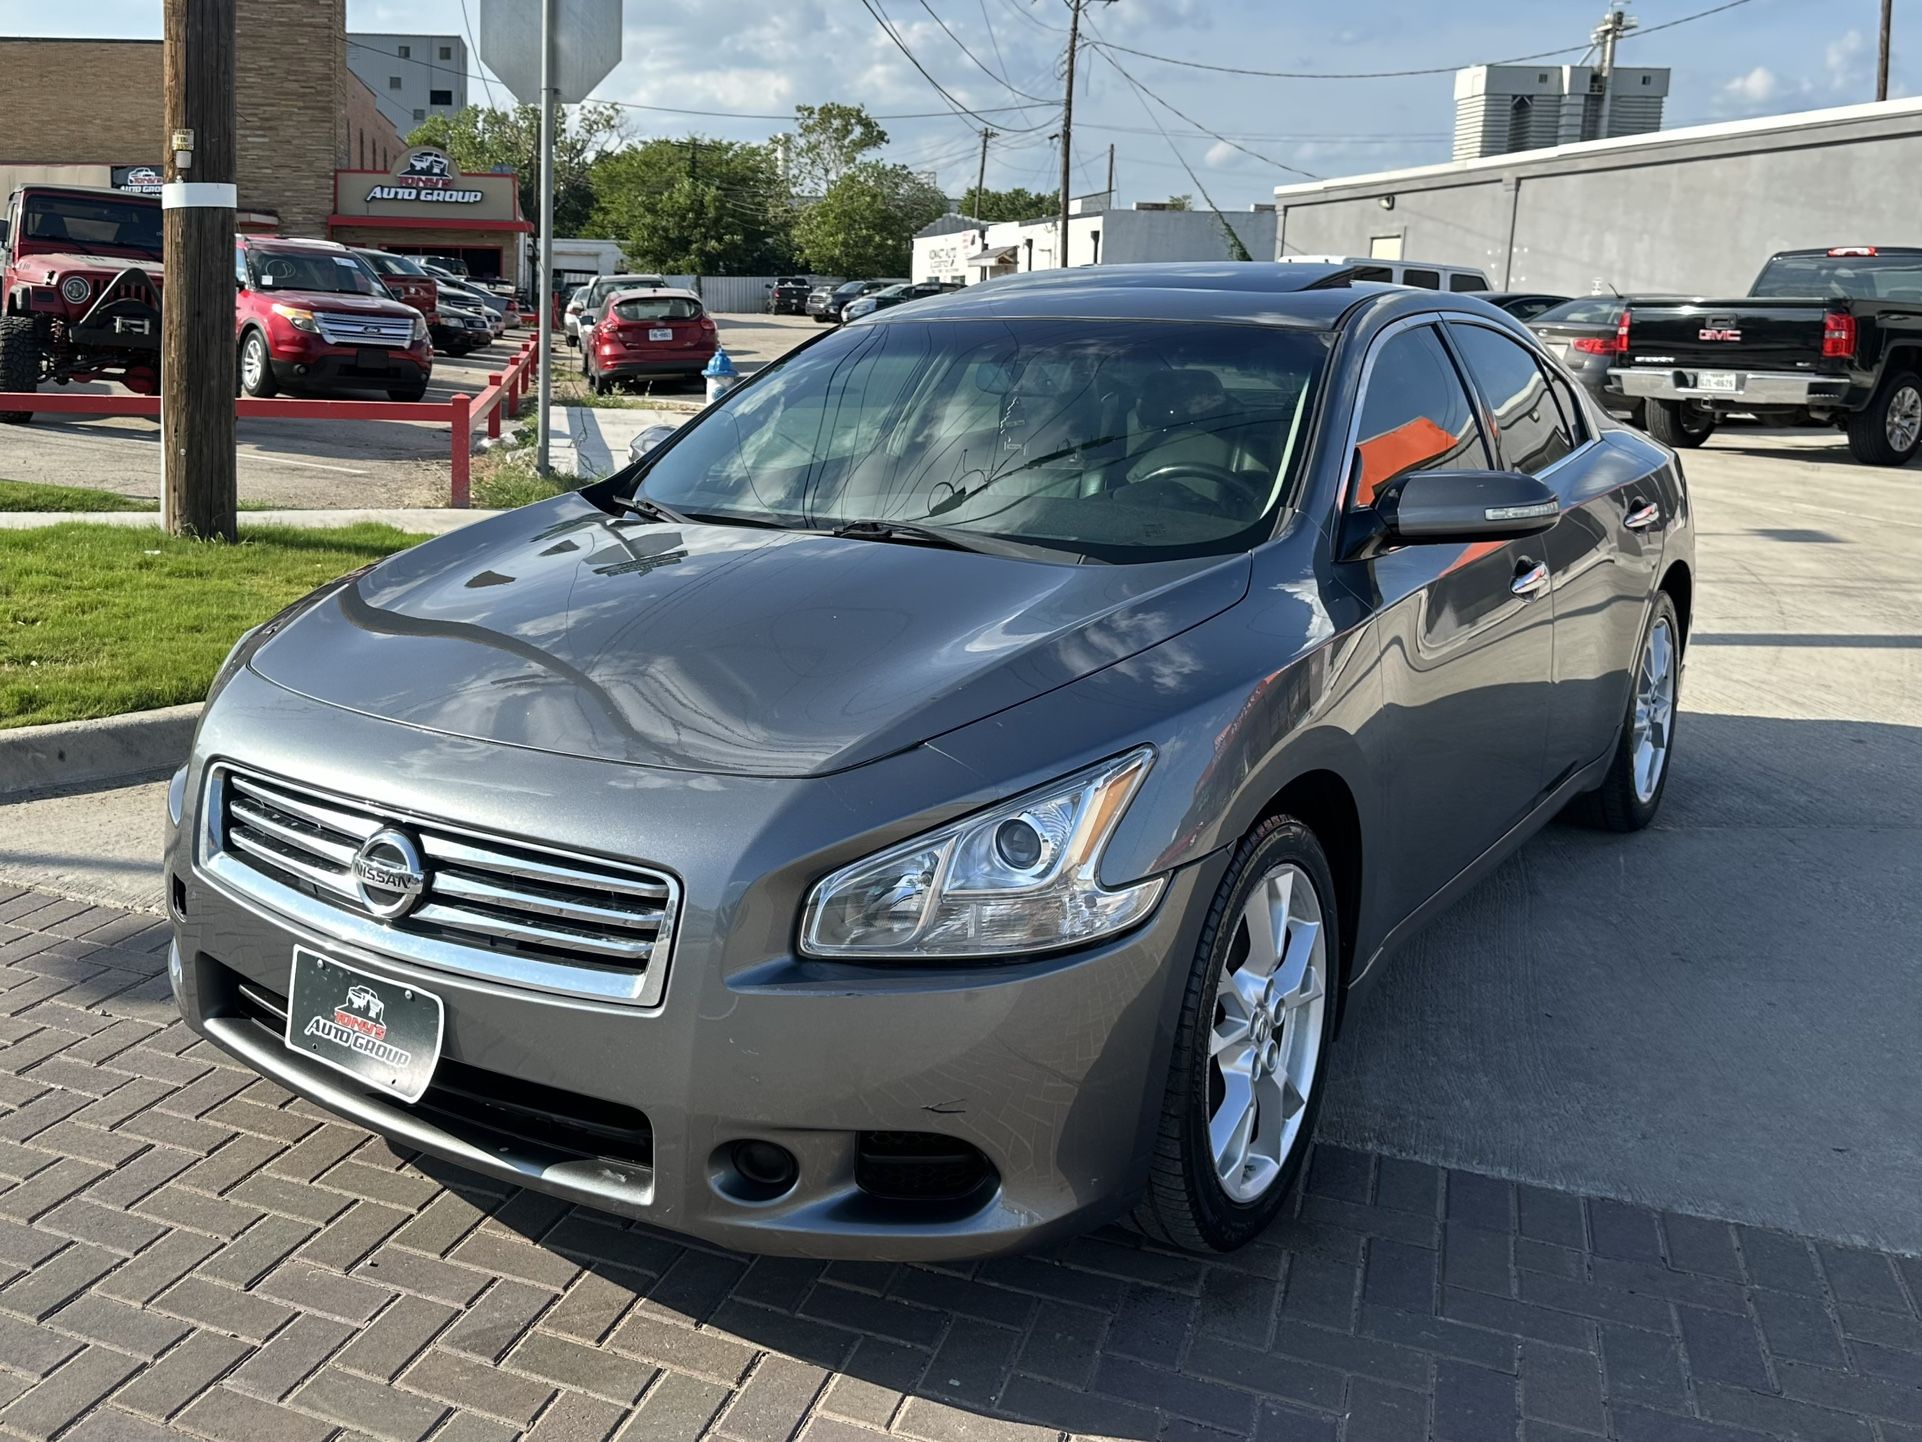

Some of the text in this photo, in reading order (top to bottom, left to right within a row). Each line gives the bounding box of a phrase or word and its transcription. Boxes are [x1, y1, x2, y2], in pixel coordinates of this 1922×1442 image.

[366, 186, 482, 203] AUTO GROUP
[1698, 329, 1742, 341] GMC
[354, 862, 412, 890] NISSAN
[334, 1011, 387, 1041] TONY'S
[304, 1016, 412, 1068] AUTO GROUP
